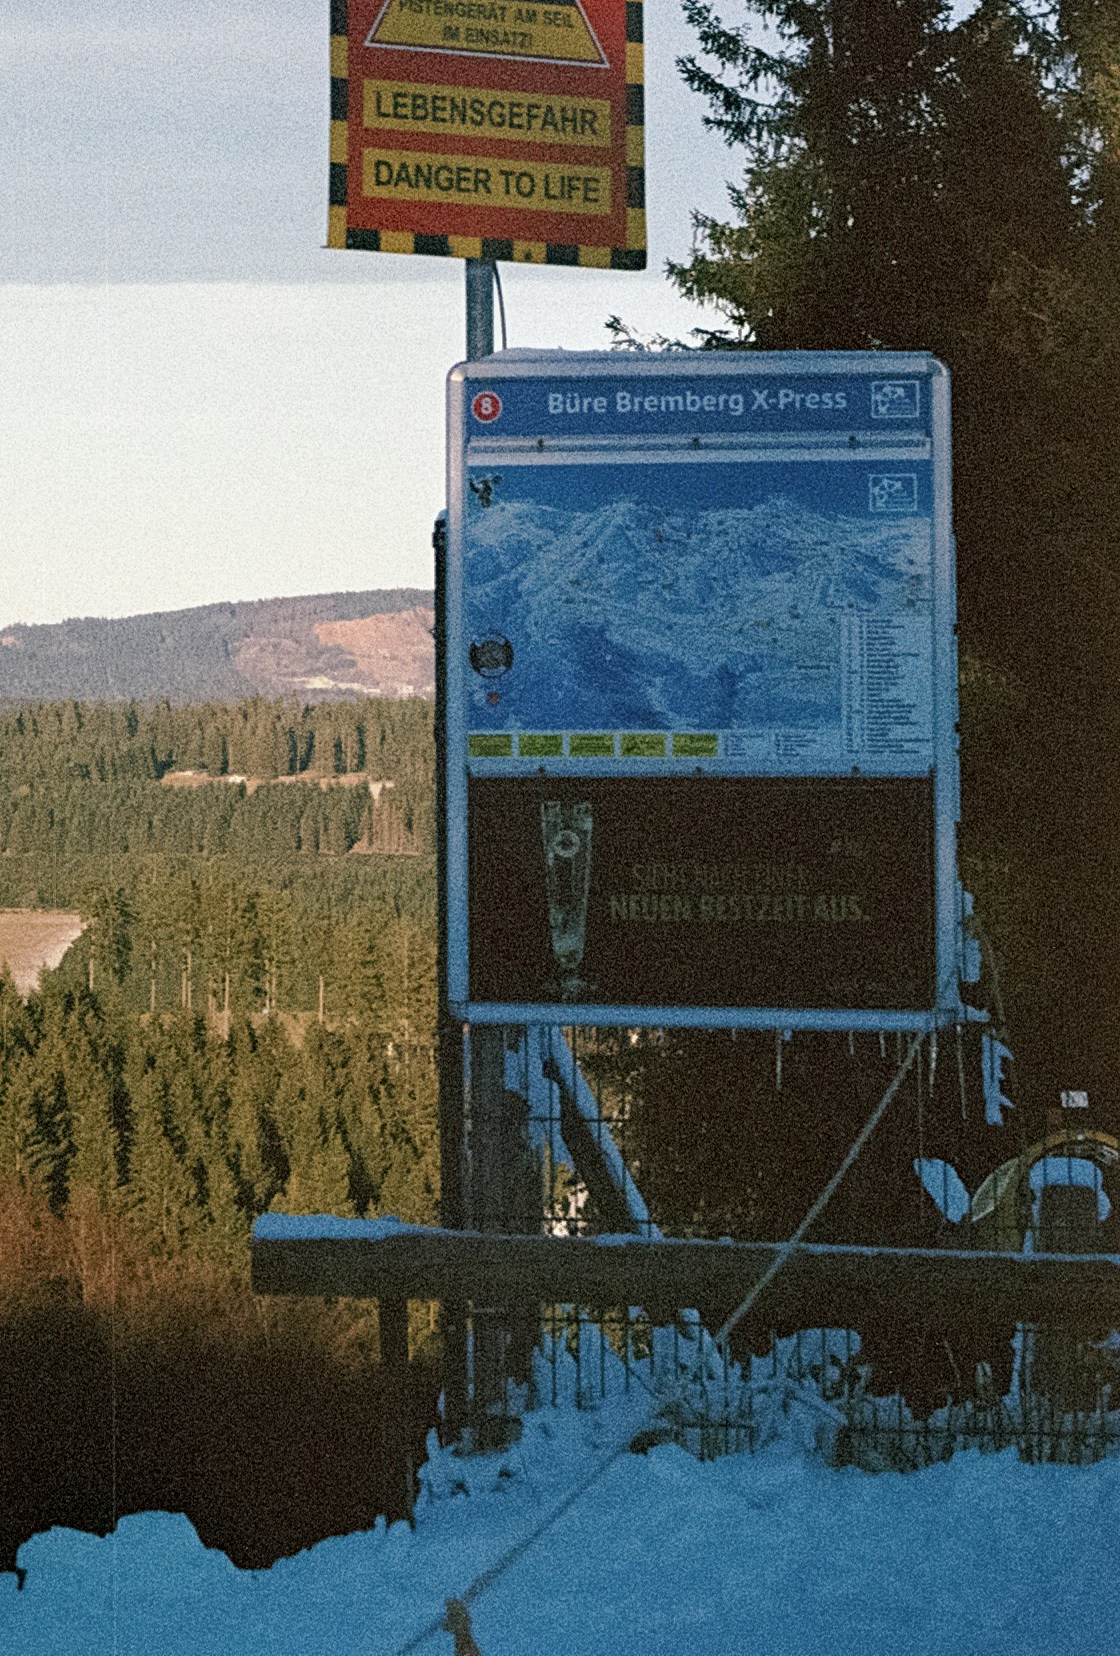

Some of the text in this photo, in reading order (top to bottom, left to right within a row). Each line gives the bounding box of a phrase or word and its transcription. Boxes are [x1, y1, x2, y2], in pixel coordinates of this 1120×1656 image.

[515, 8, 537, 24] AM
[543, 11, 575, 29] SEIL
[375, 90, 598, 136] LEBENSGEFAHR
[374, 159, 601, 203] DANGER TO LIFE
[548, 391, 607, 414] Büre
[616, 388, 745, 416] Bremberg
[751, 387, 847, 411] X-Press
[609, 894, 692, 922] NEUEN
